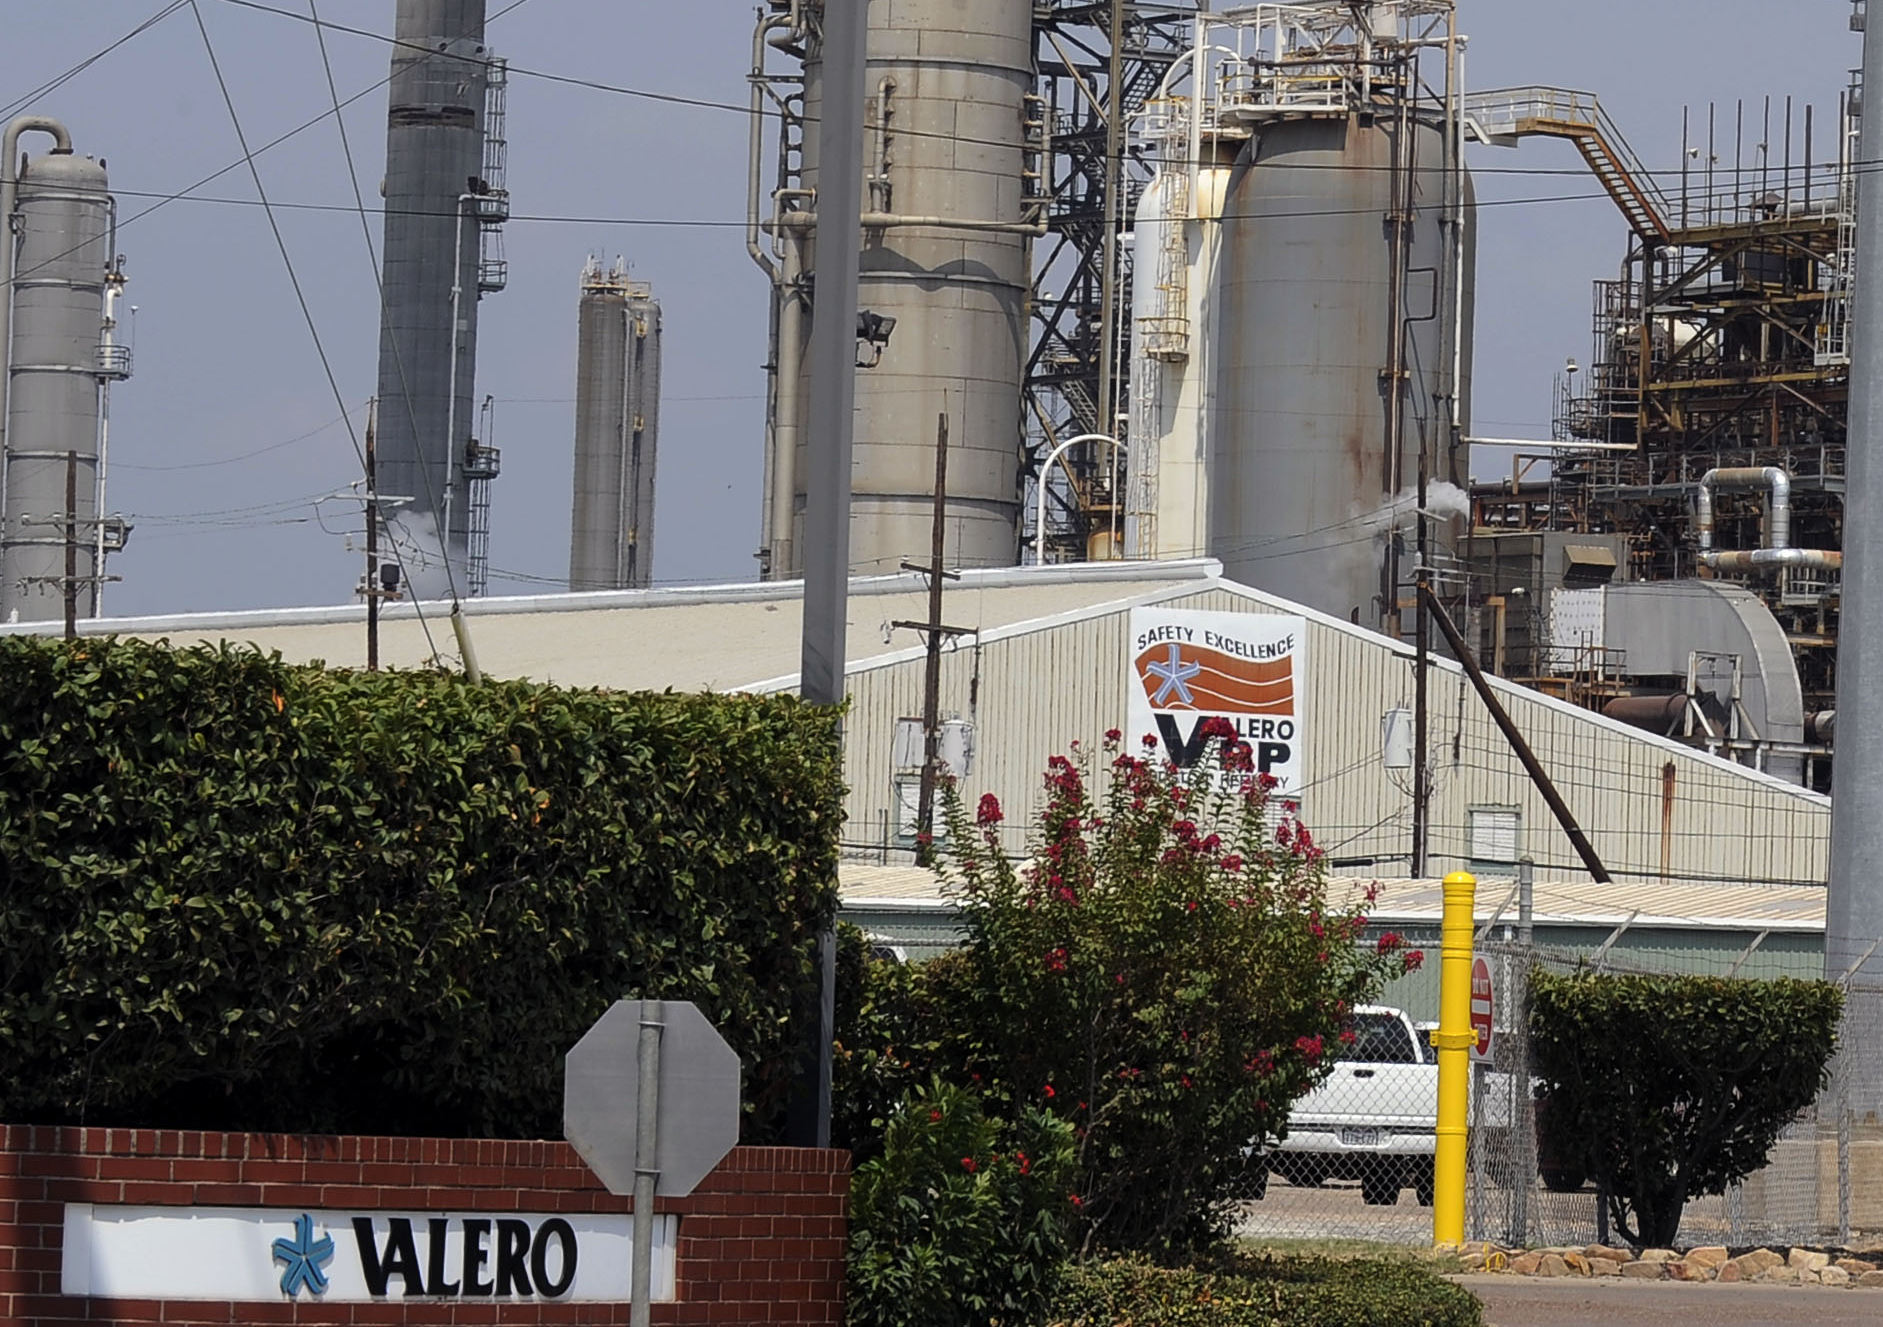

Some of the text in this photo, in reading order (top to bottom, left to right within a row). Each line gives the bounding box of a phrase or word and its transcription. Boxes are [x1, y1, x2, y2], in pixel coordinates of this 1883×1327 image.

[1137, 625, 1295, 659] SAFETY EXCELLENCE
[351, 1217, 579, 1297] VALERO
